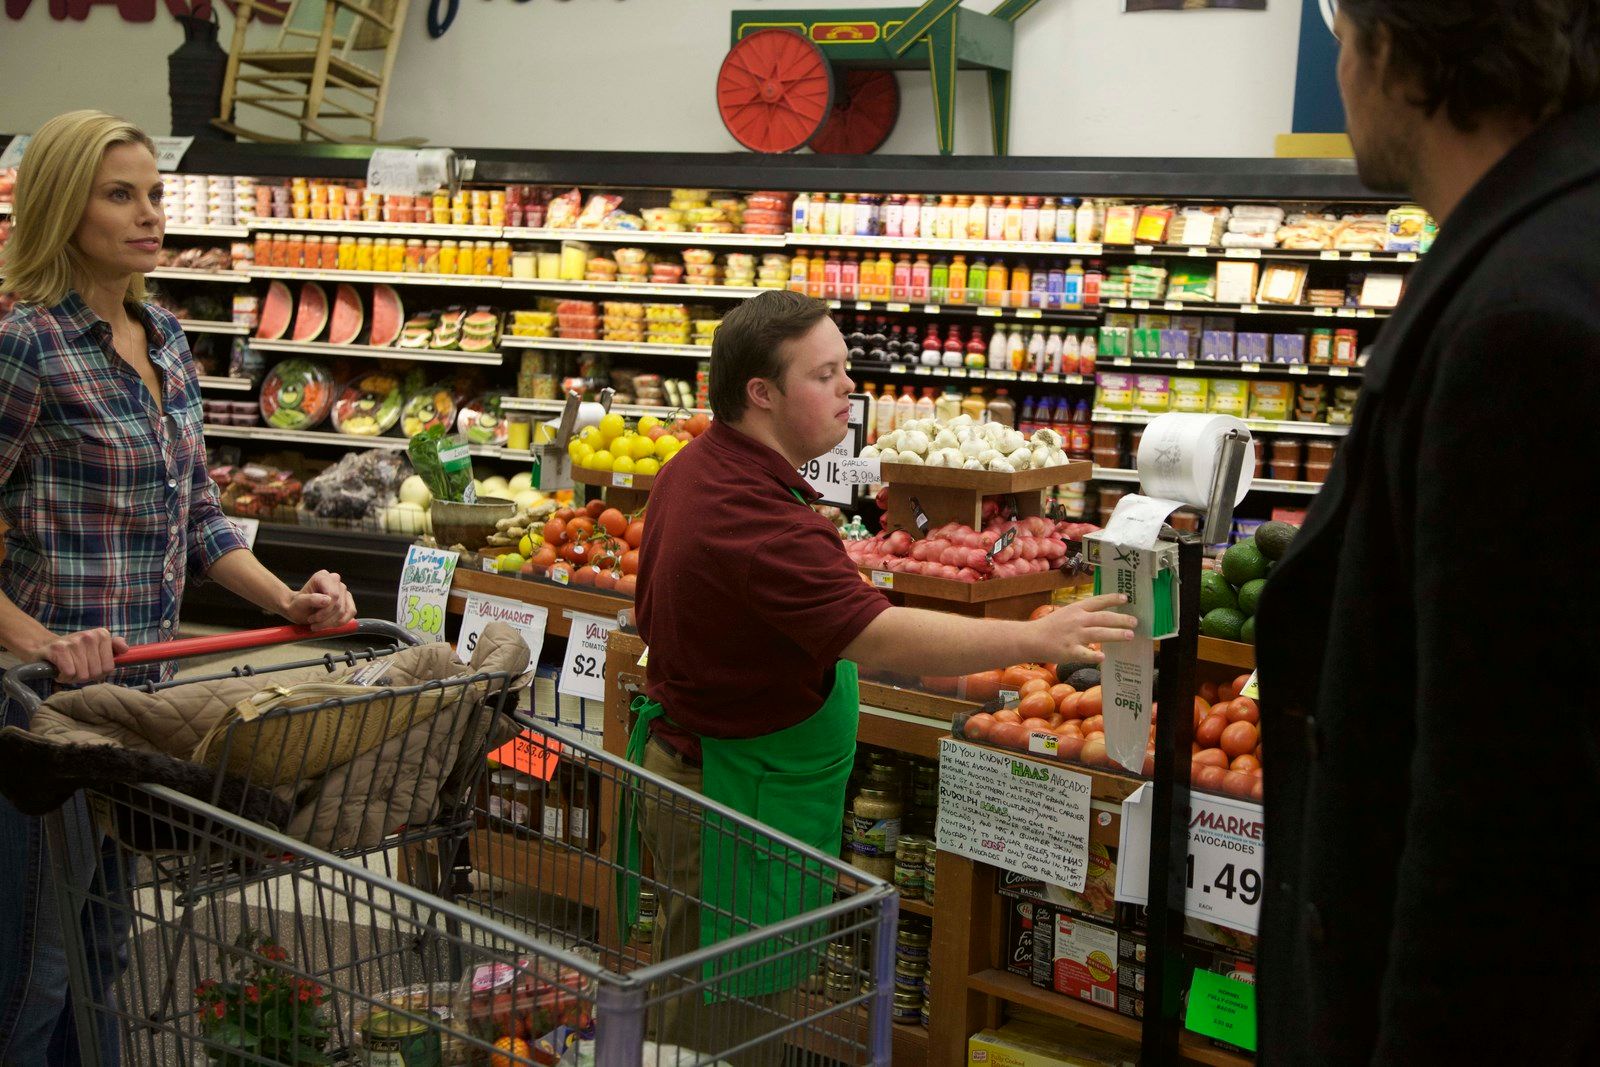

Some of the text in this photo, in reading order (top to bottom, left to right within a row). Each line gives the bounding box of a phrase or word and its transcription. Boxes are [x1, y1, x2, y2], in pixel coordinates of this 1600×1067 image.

[408, 548, 445, 570] Living
[494, 608, 534, 626] MARKET
[1115, 697, 1142, 713] OPEN
[942, 754, 951, 763] THE
[954, 757, 969, 767] HAAS
[972, 762, 998, 774] AVOCADO
[942, 740, 957, 754] DID
[979, 750, 1010, 768] KNOW?
[1010, 759, 1049, 783] HAAS
[1050, 772, 1088, 794] AVOCADO:
[940, 786, 977, 806] RUDOLPH
[1012, 815, 1026, 824] WHO
[1028, 819, 1044, 829] GAVE
[975, 782, 1004, 796] SOUTHERN
[1058, 808, 1085, 822] CARRIER
[1025, 787, 1044, 799] FIRST
[1065, 800, 1079, 810] AND
[962, 805, 990, 818] USUALLY
[1021, 824, 1044, 837] GREEN
[1046, 832, 1062, 843] THAN
[979, 819, 991, 827] AND
[995, 825, 1008, 834] HAS
[1019, 832, 1049, 846] BUMPIER
[939, 826, 966, 840] AVOCADO
[1007, 846, 1023, 859] ONLY
[1026, 853, 1050, 865] GROWN
[1062, 865, 1077, 874] THE
[940, 816, 976, 835] CONTRARY
[1050, 852, 1062, 860] THE
[1062, 853, 1083, 868] HAAS
[1194, 833, 1254, 855] AVOCADOES
[969, 845, 1000, 860] AVOCADOS
[1004, 856, 1016, 866] ARE
[1021, 860, 1038, 872] GOOD
[1041, 867, 1052, 877] FOR
[1020, 888, 1043, 898] BACON
[1198, 902, 1212, 911] EACH
